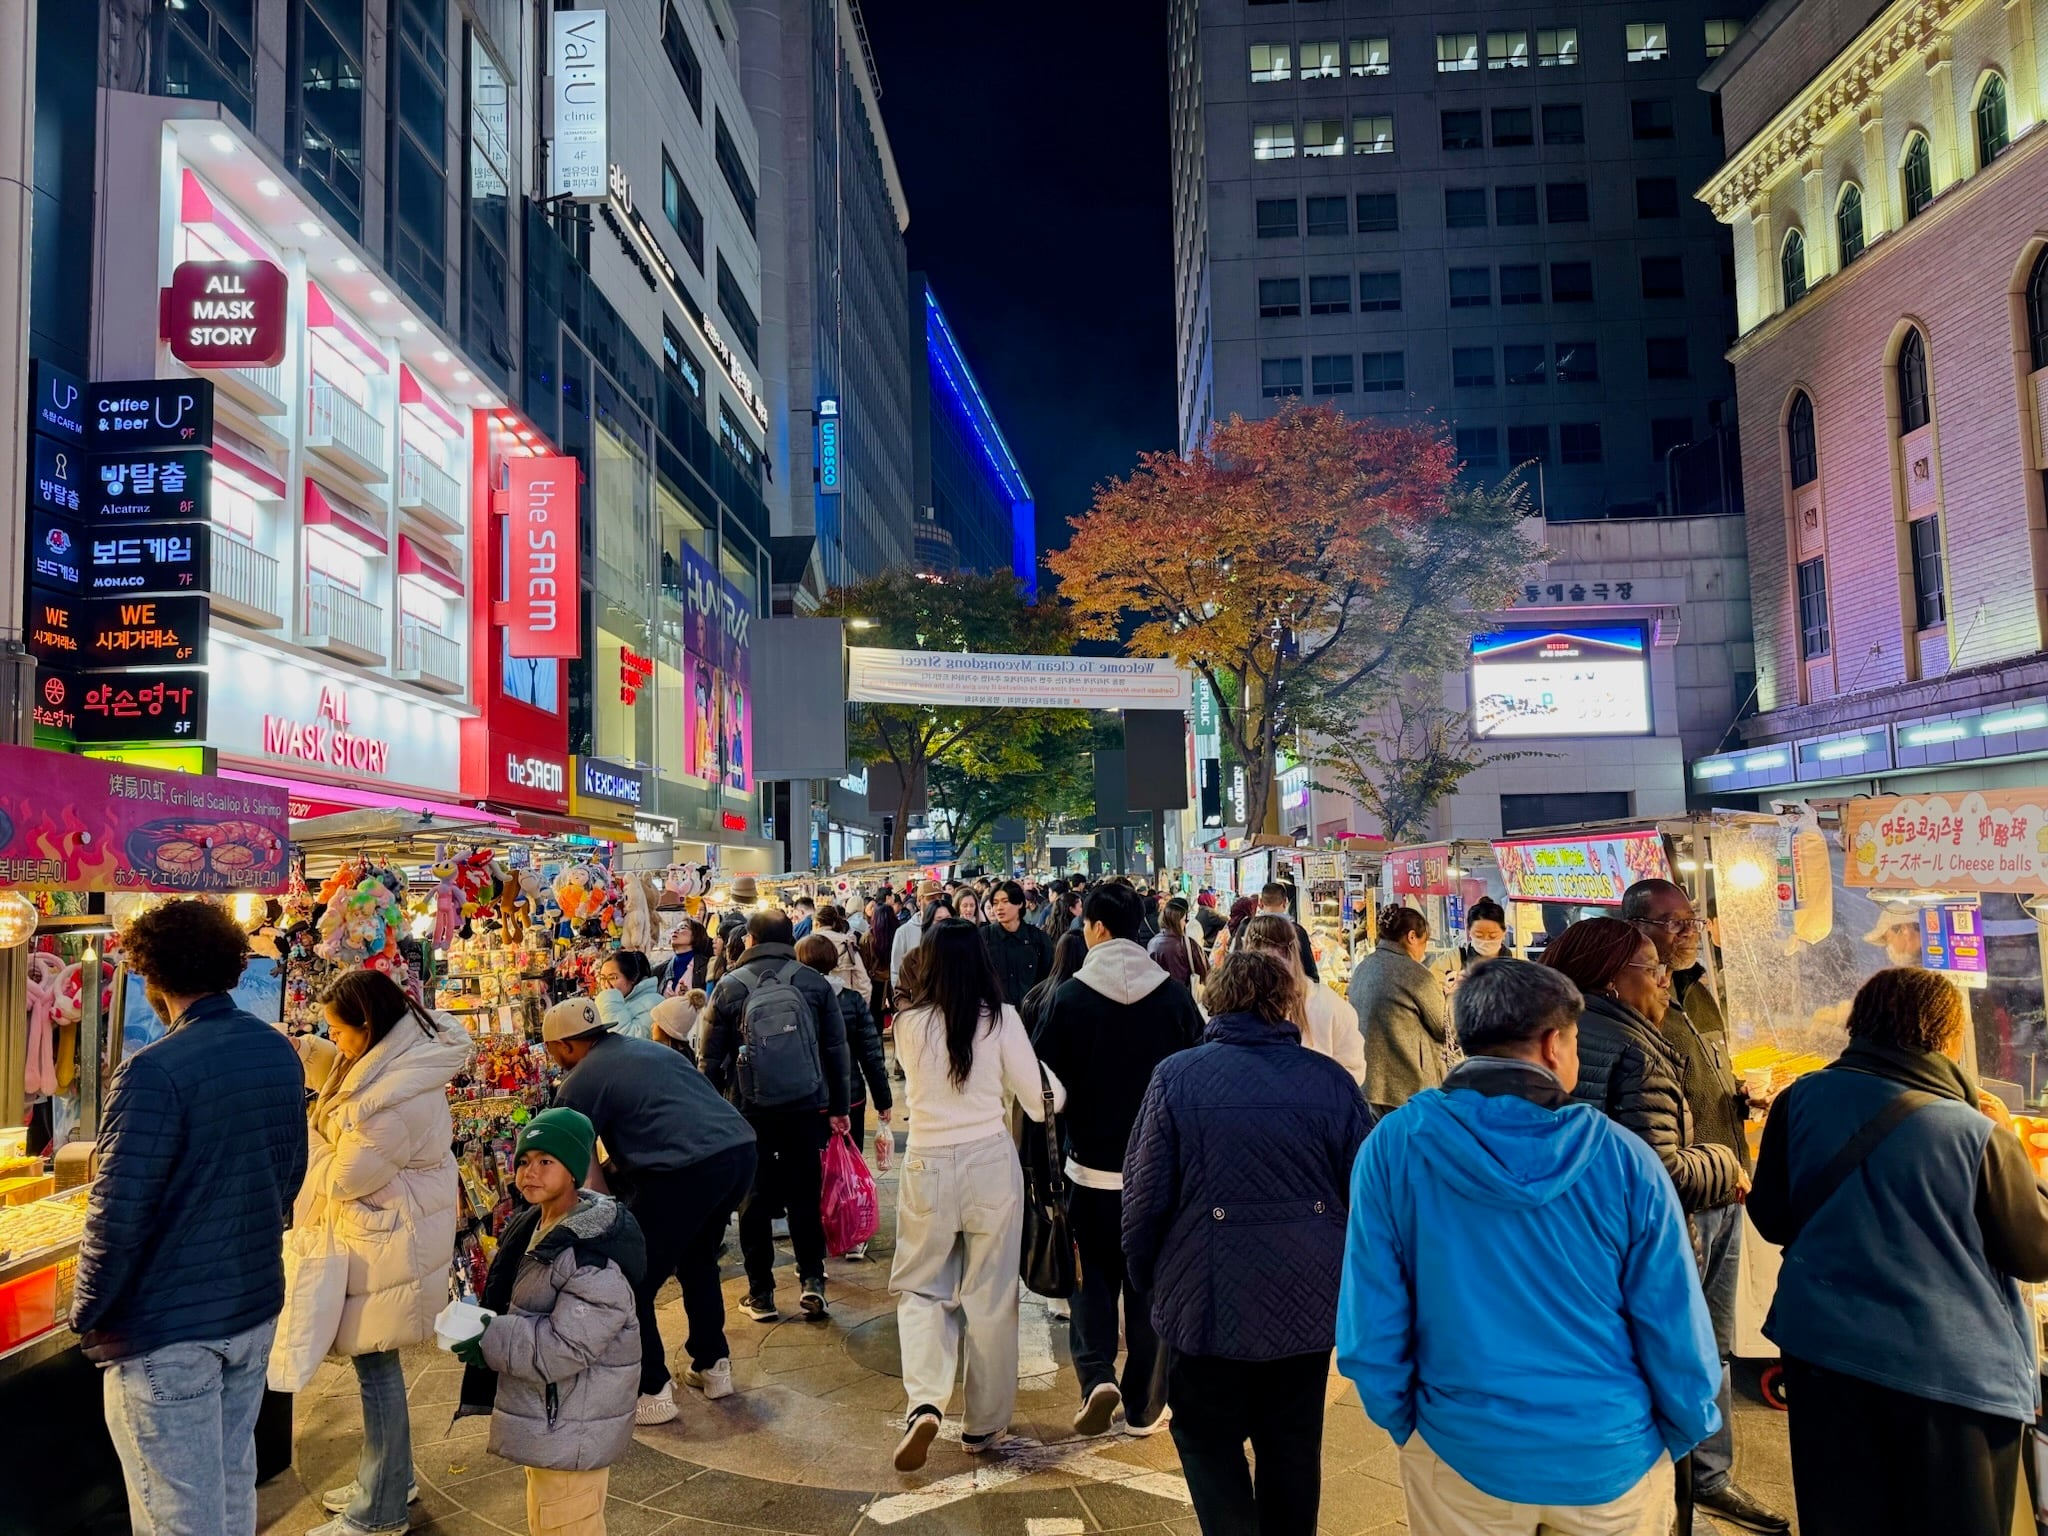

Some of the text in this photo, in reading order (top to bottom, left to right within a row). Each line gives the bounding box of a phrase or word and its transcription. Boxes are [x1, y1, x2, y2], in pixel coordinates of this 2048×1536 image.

[564, 20, 596, 105] Val:U
[564, 112, 596, 122] clinic
[573, 150, 587, 161] 4F
[206, 276, 245, 293] ALL
[194, 302, 254, 319] MASK
[190, 328, 256, 345] STORY
[98, 399, 150, 413] Coffee
[98, 417, 149, 431] & Beer
[180, 428, 196, 440] 9F
[822, 422, 836, 486] unesco
[101, 462, 187, 496] 방탈출
[40, 479, 81, 511] 방탈출
[100, 504, 151, 515] Alcatraz
[179, 500, 195, 513] 8F
[93, 537, 192, 565] 보드게임
[529, 481, 556, 632] the SAEM
[36, 557, 79, 583] 보드게임
[178, 573, 194, 586] 7F
[93, 576, 145, 588] MONACO
[1525, 581, 1634, 602] 동예술극장
[45, 606, 69, 628] WE
[121, 604, 156, 626] WE
[33, 630, 78, 650] 시계거래소
[95, 629, 180, 651] 시계거래소
[176, 647, 193, 659] 6F
[84, 682, 194, 717] 약손명가
[319, 686, 351, 723] ALL
[1200, 678, 1210, 726] REPUBLIC
[174, 721, 191, 733] 5F
[264, 714, 389, 774] MASK STORY
[507, 754, 563, 793] the SAEM
[595, 771, 641, 802] EXCHANGE
[170, 790, 205, 807] Grilled
[206, 793, 241, 812] Scallop
[243, 798, 251, 811] &
[252, 800, 281, 817] Shrimp
[1979, 815, 2028, 848] 奶酪球
[1880, 853, 2032, 871] チーズボール Cheese balls
[1517, 869, 1614, 898] Korean octopus
